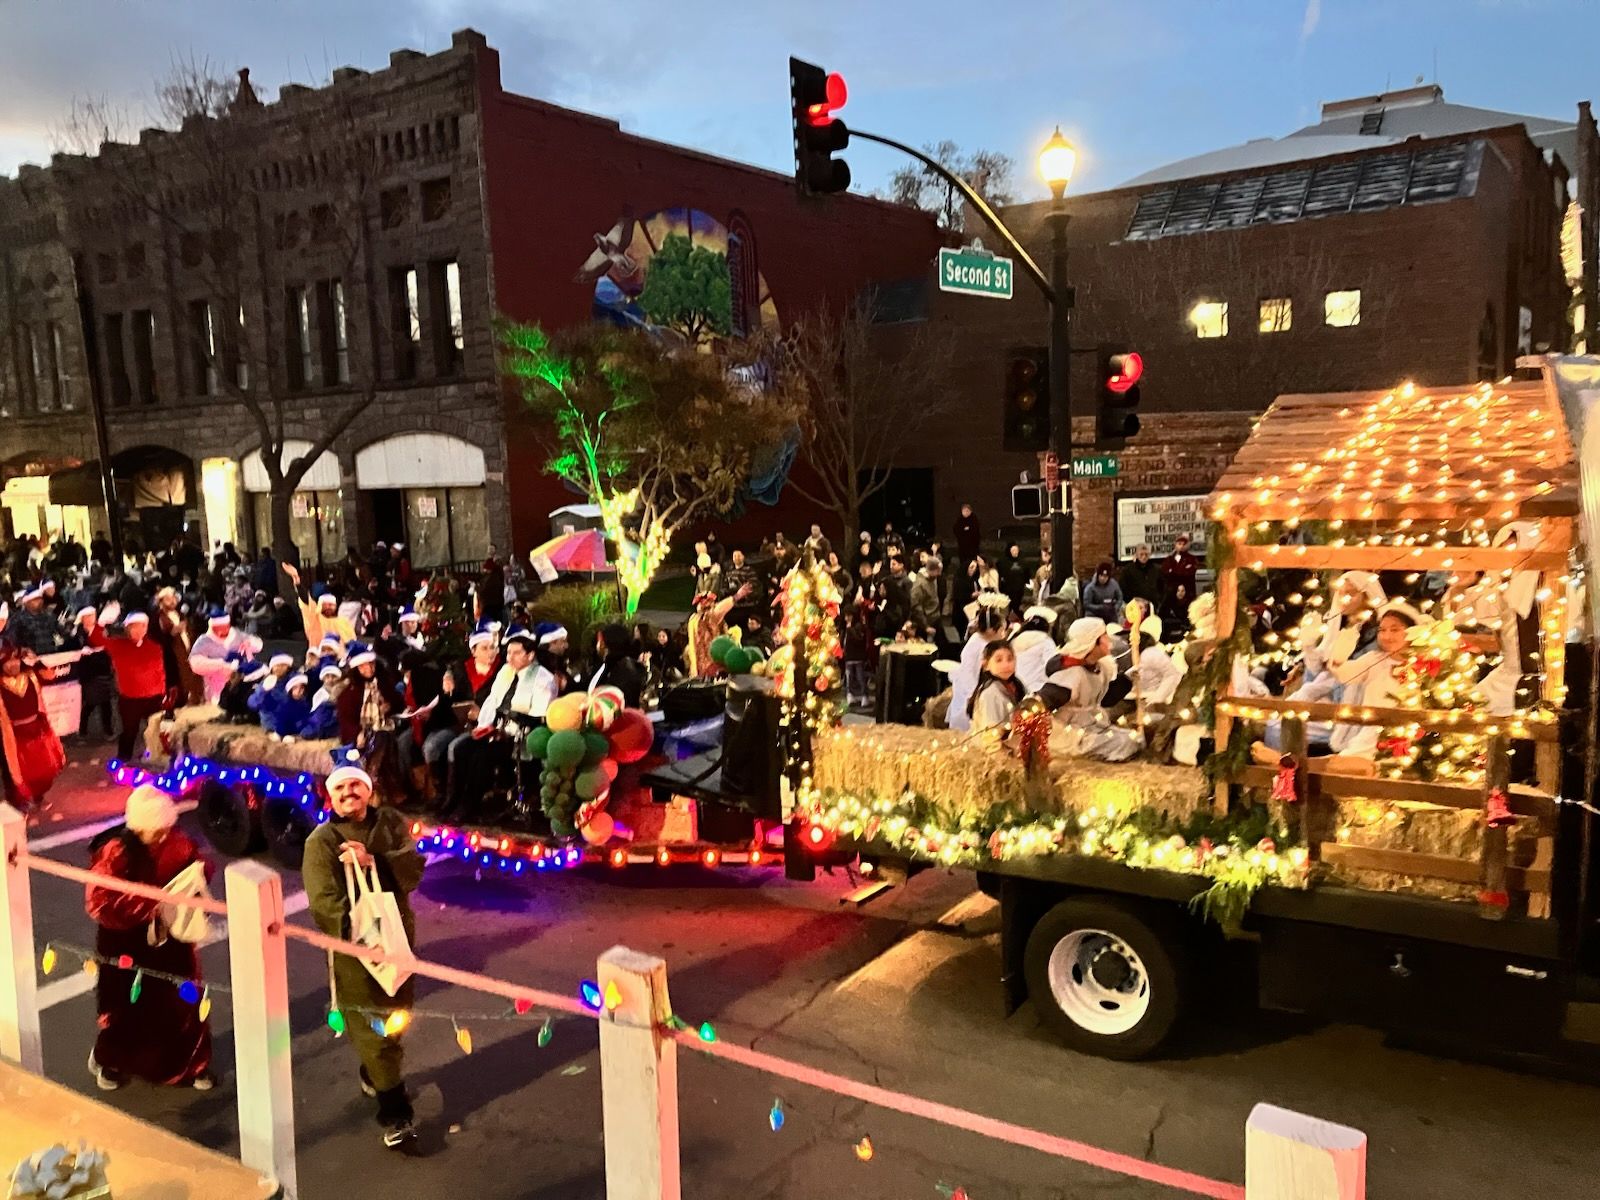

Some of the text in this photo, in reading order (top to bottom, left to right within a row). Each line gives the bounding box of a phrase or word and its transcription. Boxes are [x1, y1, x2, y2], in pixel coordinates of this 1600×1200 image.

[946, 258, 1008, 290] Second St
[1073, 459, 1115, 475] Main St
[1134, 502, 1146, 514] THE
[1144, 523, 1166, 534] WHITE
